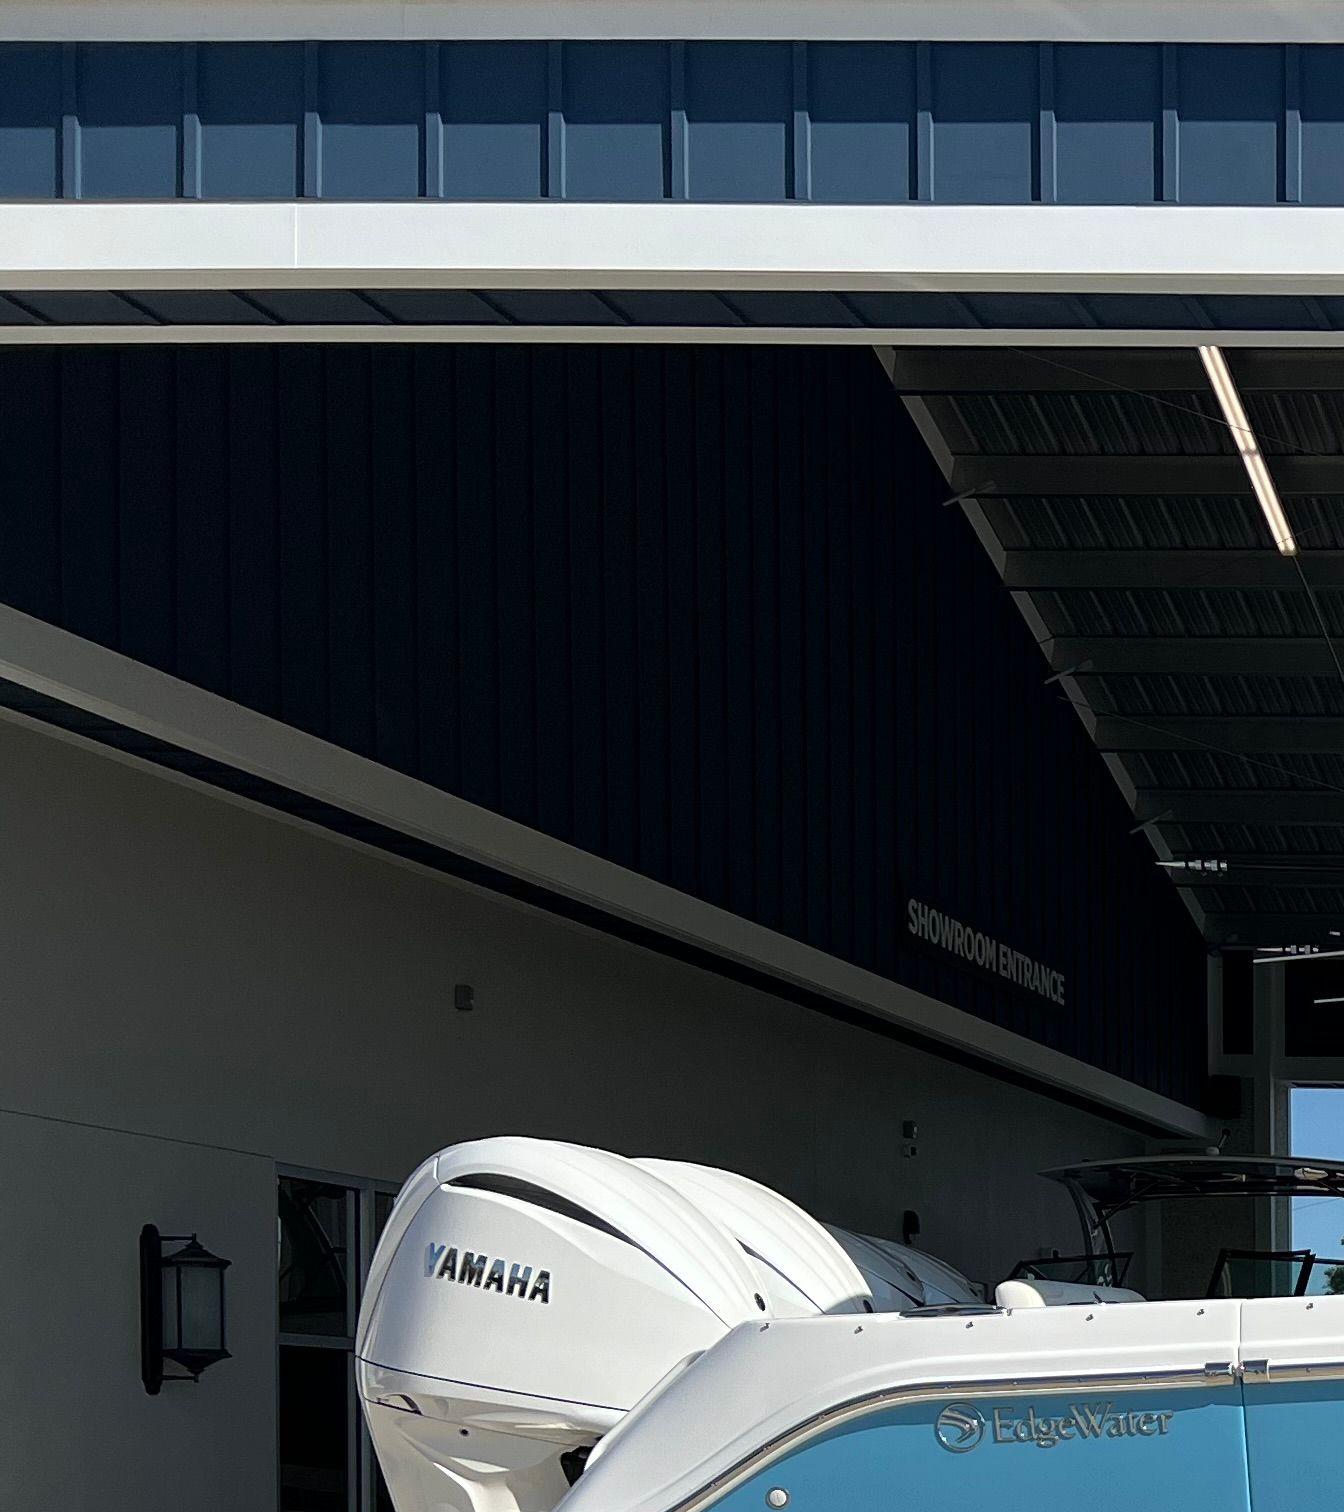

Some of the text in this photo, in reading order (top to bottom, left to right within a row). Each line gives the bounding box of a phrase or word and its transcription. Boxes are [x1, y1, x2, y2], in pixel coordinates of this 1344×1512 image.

[908, 898, 1065, 1006] SHOWROOM ENTRANCE
[424, 1242, 551, 1304] YAMAHA
[992, 1401, 1174, 1448] EdgeWater
